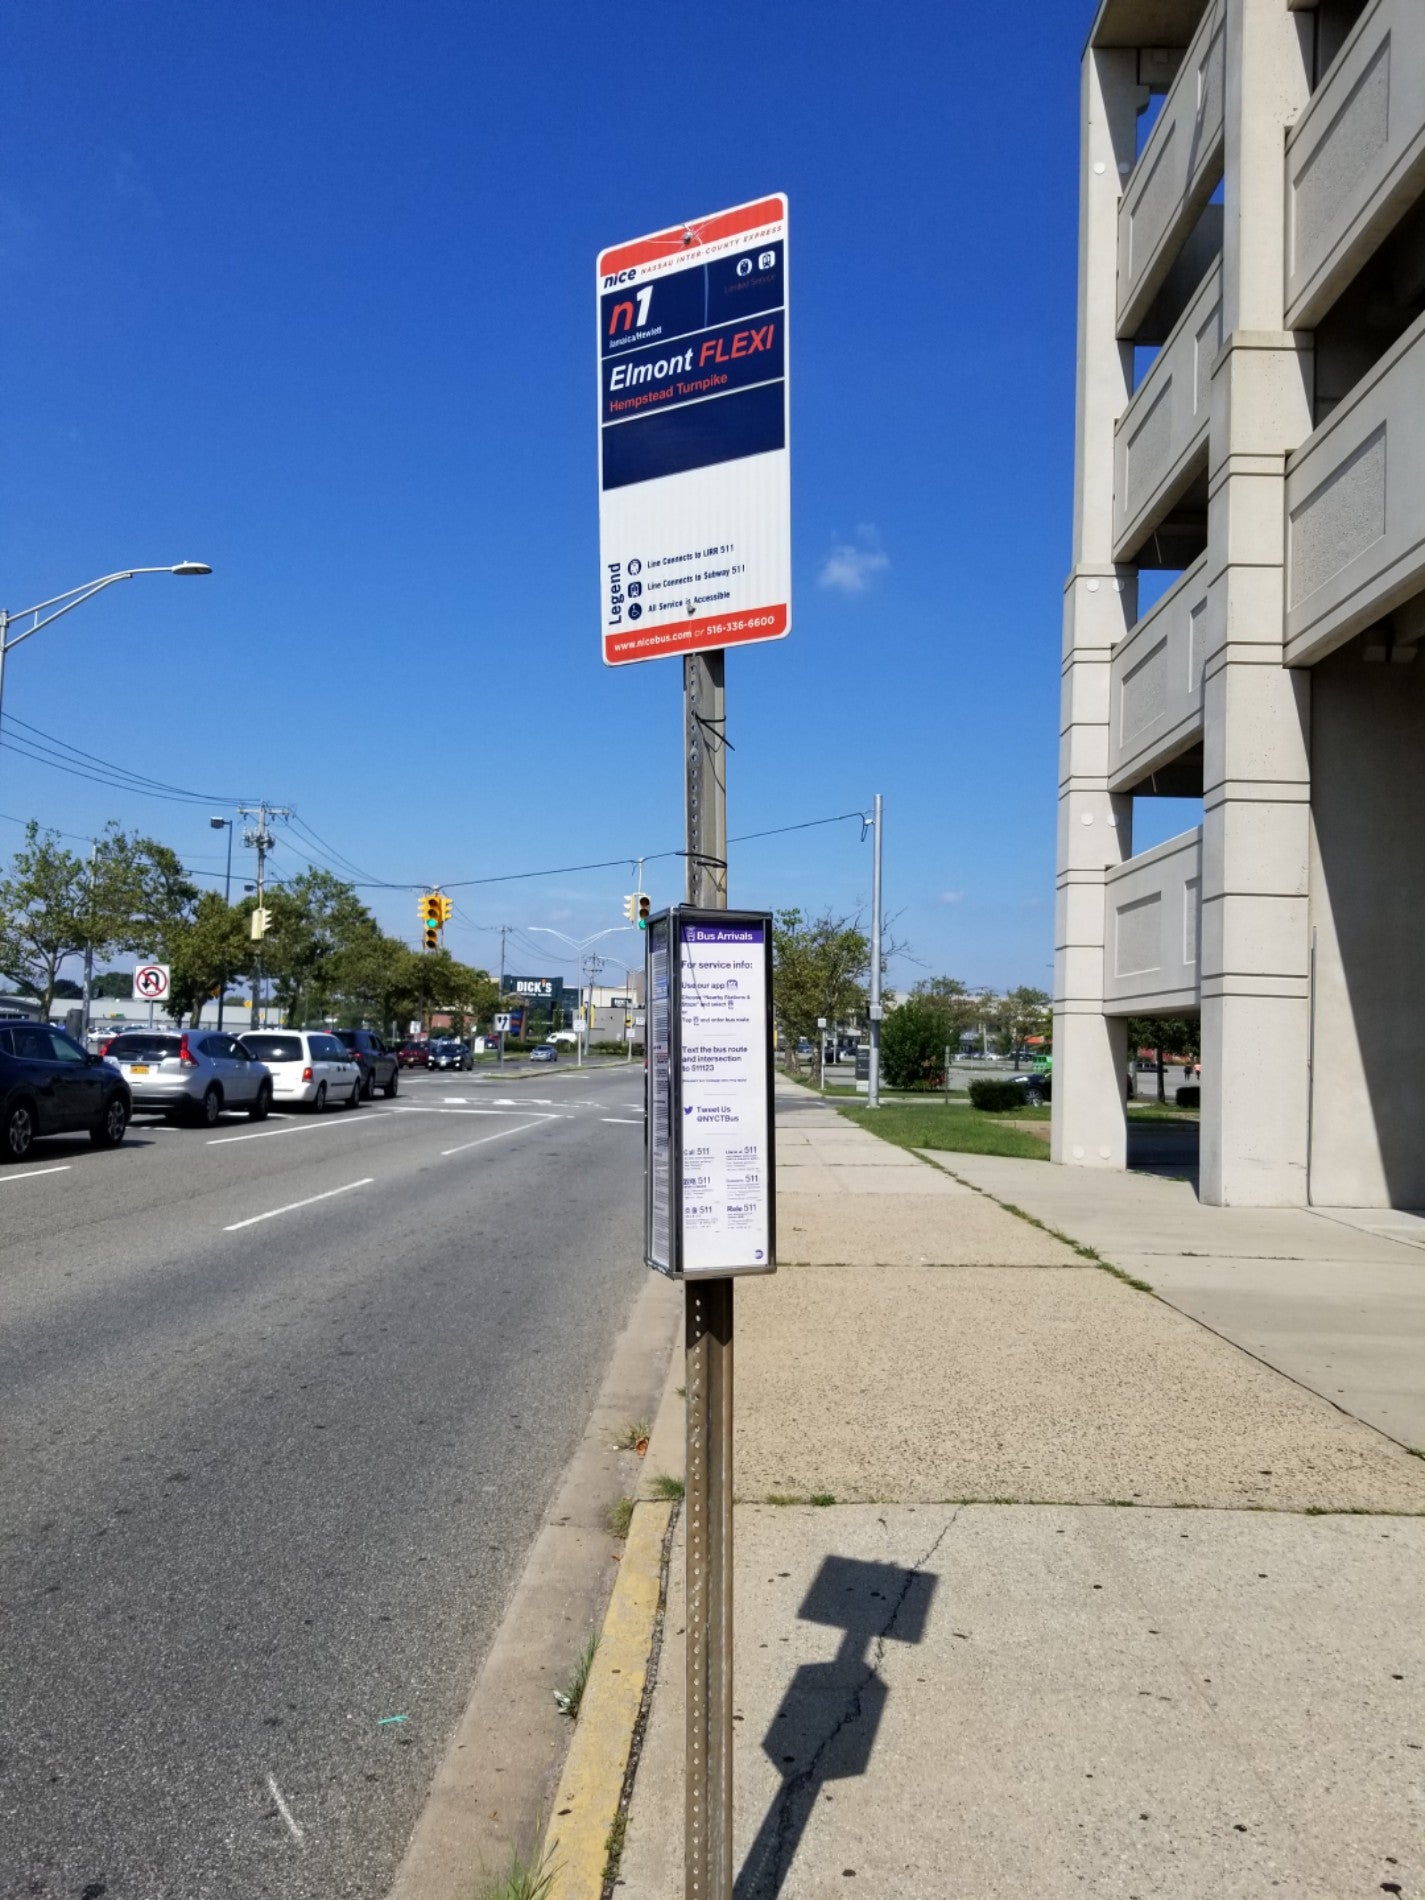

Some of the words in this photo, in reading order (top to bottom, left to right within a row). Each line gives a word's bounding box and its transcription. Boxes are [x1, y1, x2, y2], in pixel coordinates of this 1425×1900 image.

[604, 268, 637, 289] nice
[641, 259, 674, 275] NASSAU
[676, 238, 740, 265] INTER-COUNTY
[743, 225, 782, 243] EXPRESS
[608, 285, 653, 335] n1
[610, 348, 693, 391] Elmont
[699, 324, 774, 367] FLEXI
[609, 385, 673, 412] Hempstead
[676, 374, 728, 395] Turnpike
[647, 560, 661, 569] Line
[662, 552, 693, 566] Connects
[703, 547, 719, 557] LIRR
[720, 544, 734, 554] 511
[647, 582, 661, 591] Line
[663, 575, 693, 588] Connects
[703, 569, 730, 580] Subway
[731, 564, 745, 574] 511
[608, 562, 625, 625] Legend
[648, 604, 657, 612] All
[659, 599, 683, 611] Service
[694, 590, 730, 604] Accessible
[614, 630, 692, 651] www.nicebus.com
[695, 628, 705, 637] or
[706, 615, 775, 635] 516-336-6600
[697, 931, 715, 940] Bus
[717, 931, 753, 940] Arrivals
[681, 960, 696, 969] For
[699, 960, 731, 969] service
[733, 960, 753, 969] info:
[516, 979, 552, 993] DICK'S
[697, 1147, 710, 1155] 511
[744, 1146, 757, 1154] 511
[698, 1176, 711, 1184] 511
[745, 1174, 758, 1182] 511
[699, 1205, 712, 1213] 511
[744, 1203, 757, 1211] 511
